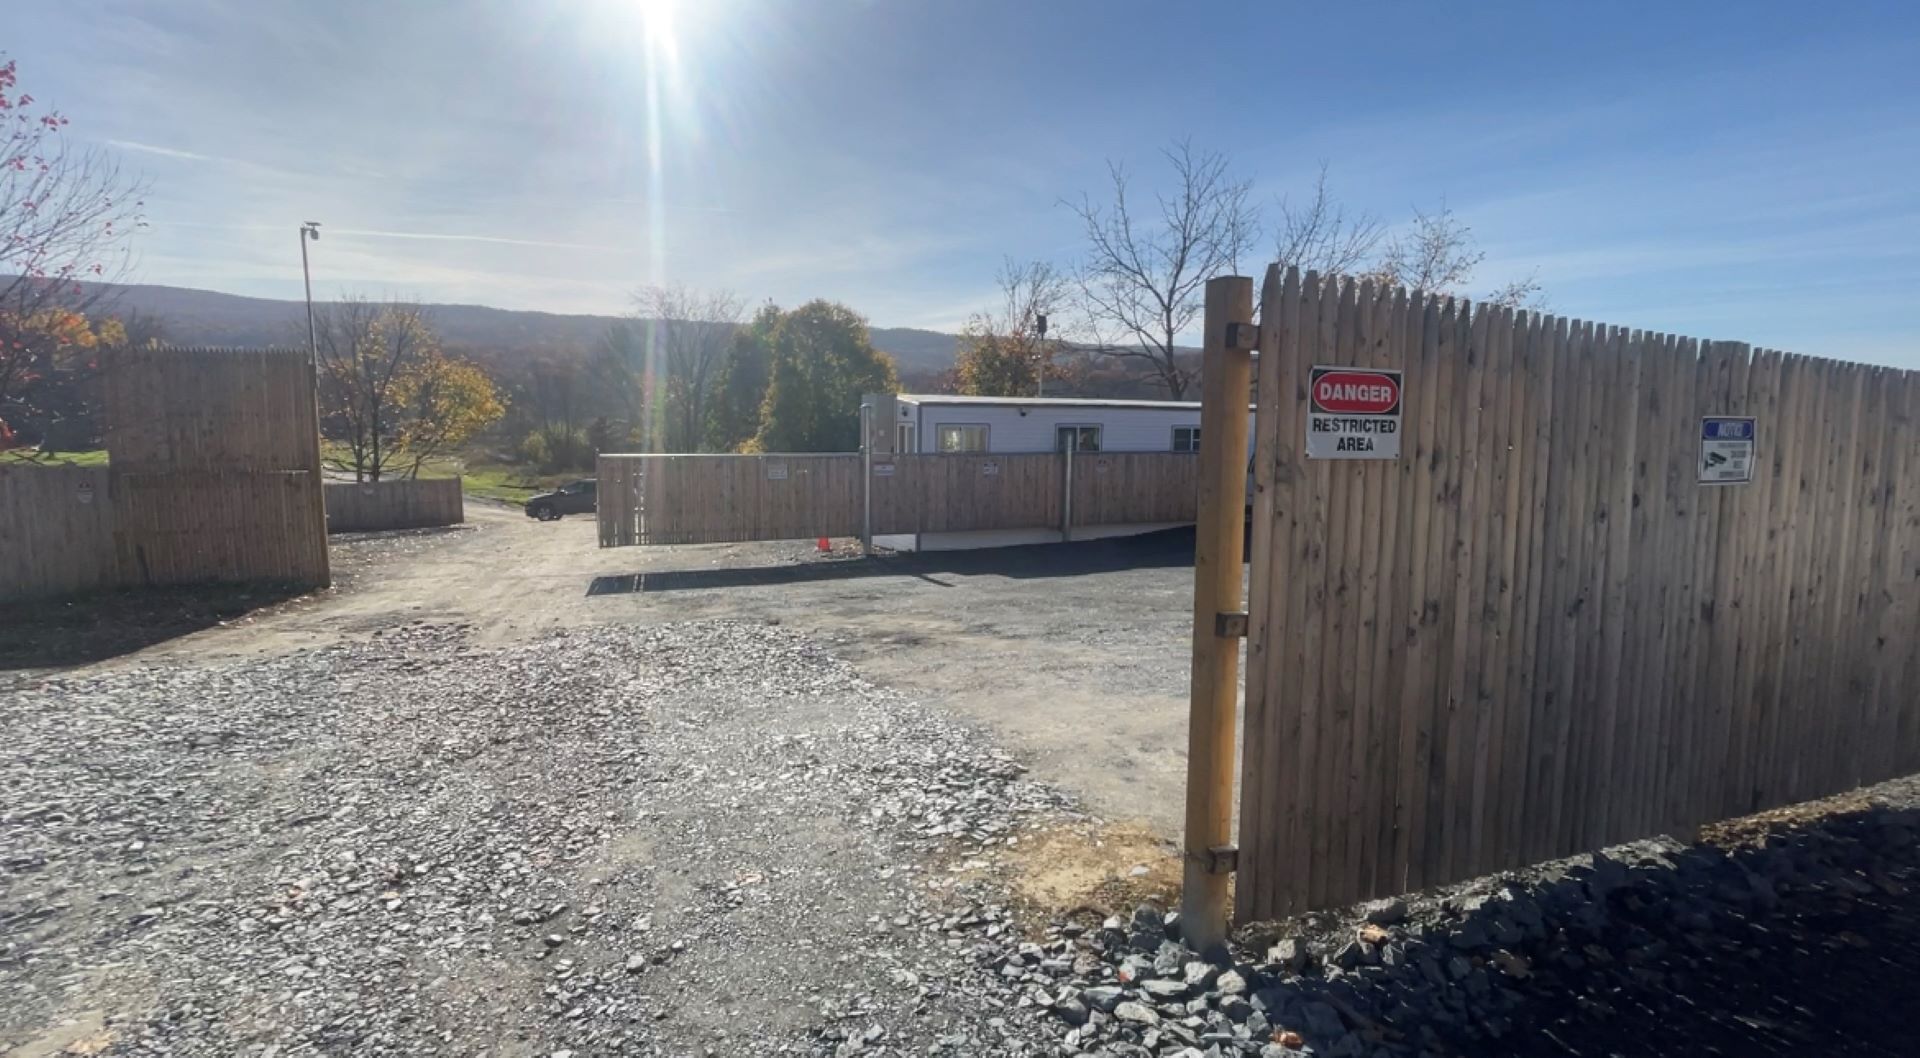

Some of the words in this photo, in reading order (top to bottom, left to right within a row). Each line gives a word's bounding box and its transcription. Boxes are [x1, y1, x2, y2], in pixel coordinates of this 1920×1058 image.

[1320, 383, 1392, 402] DANGER
[1313, 417, 1397, 434] RESTRICTED
[1336, 437, 1374, 452] AREA
